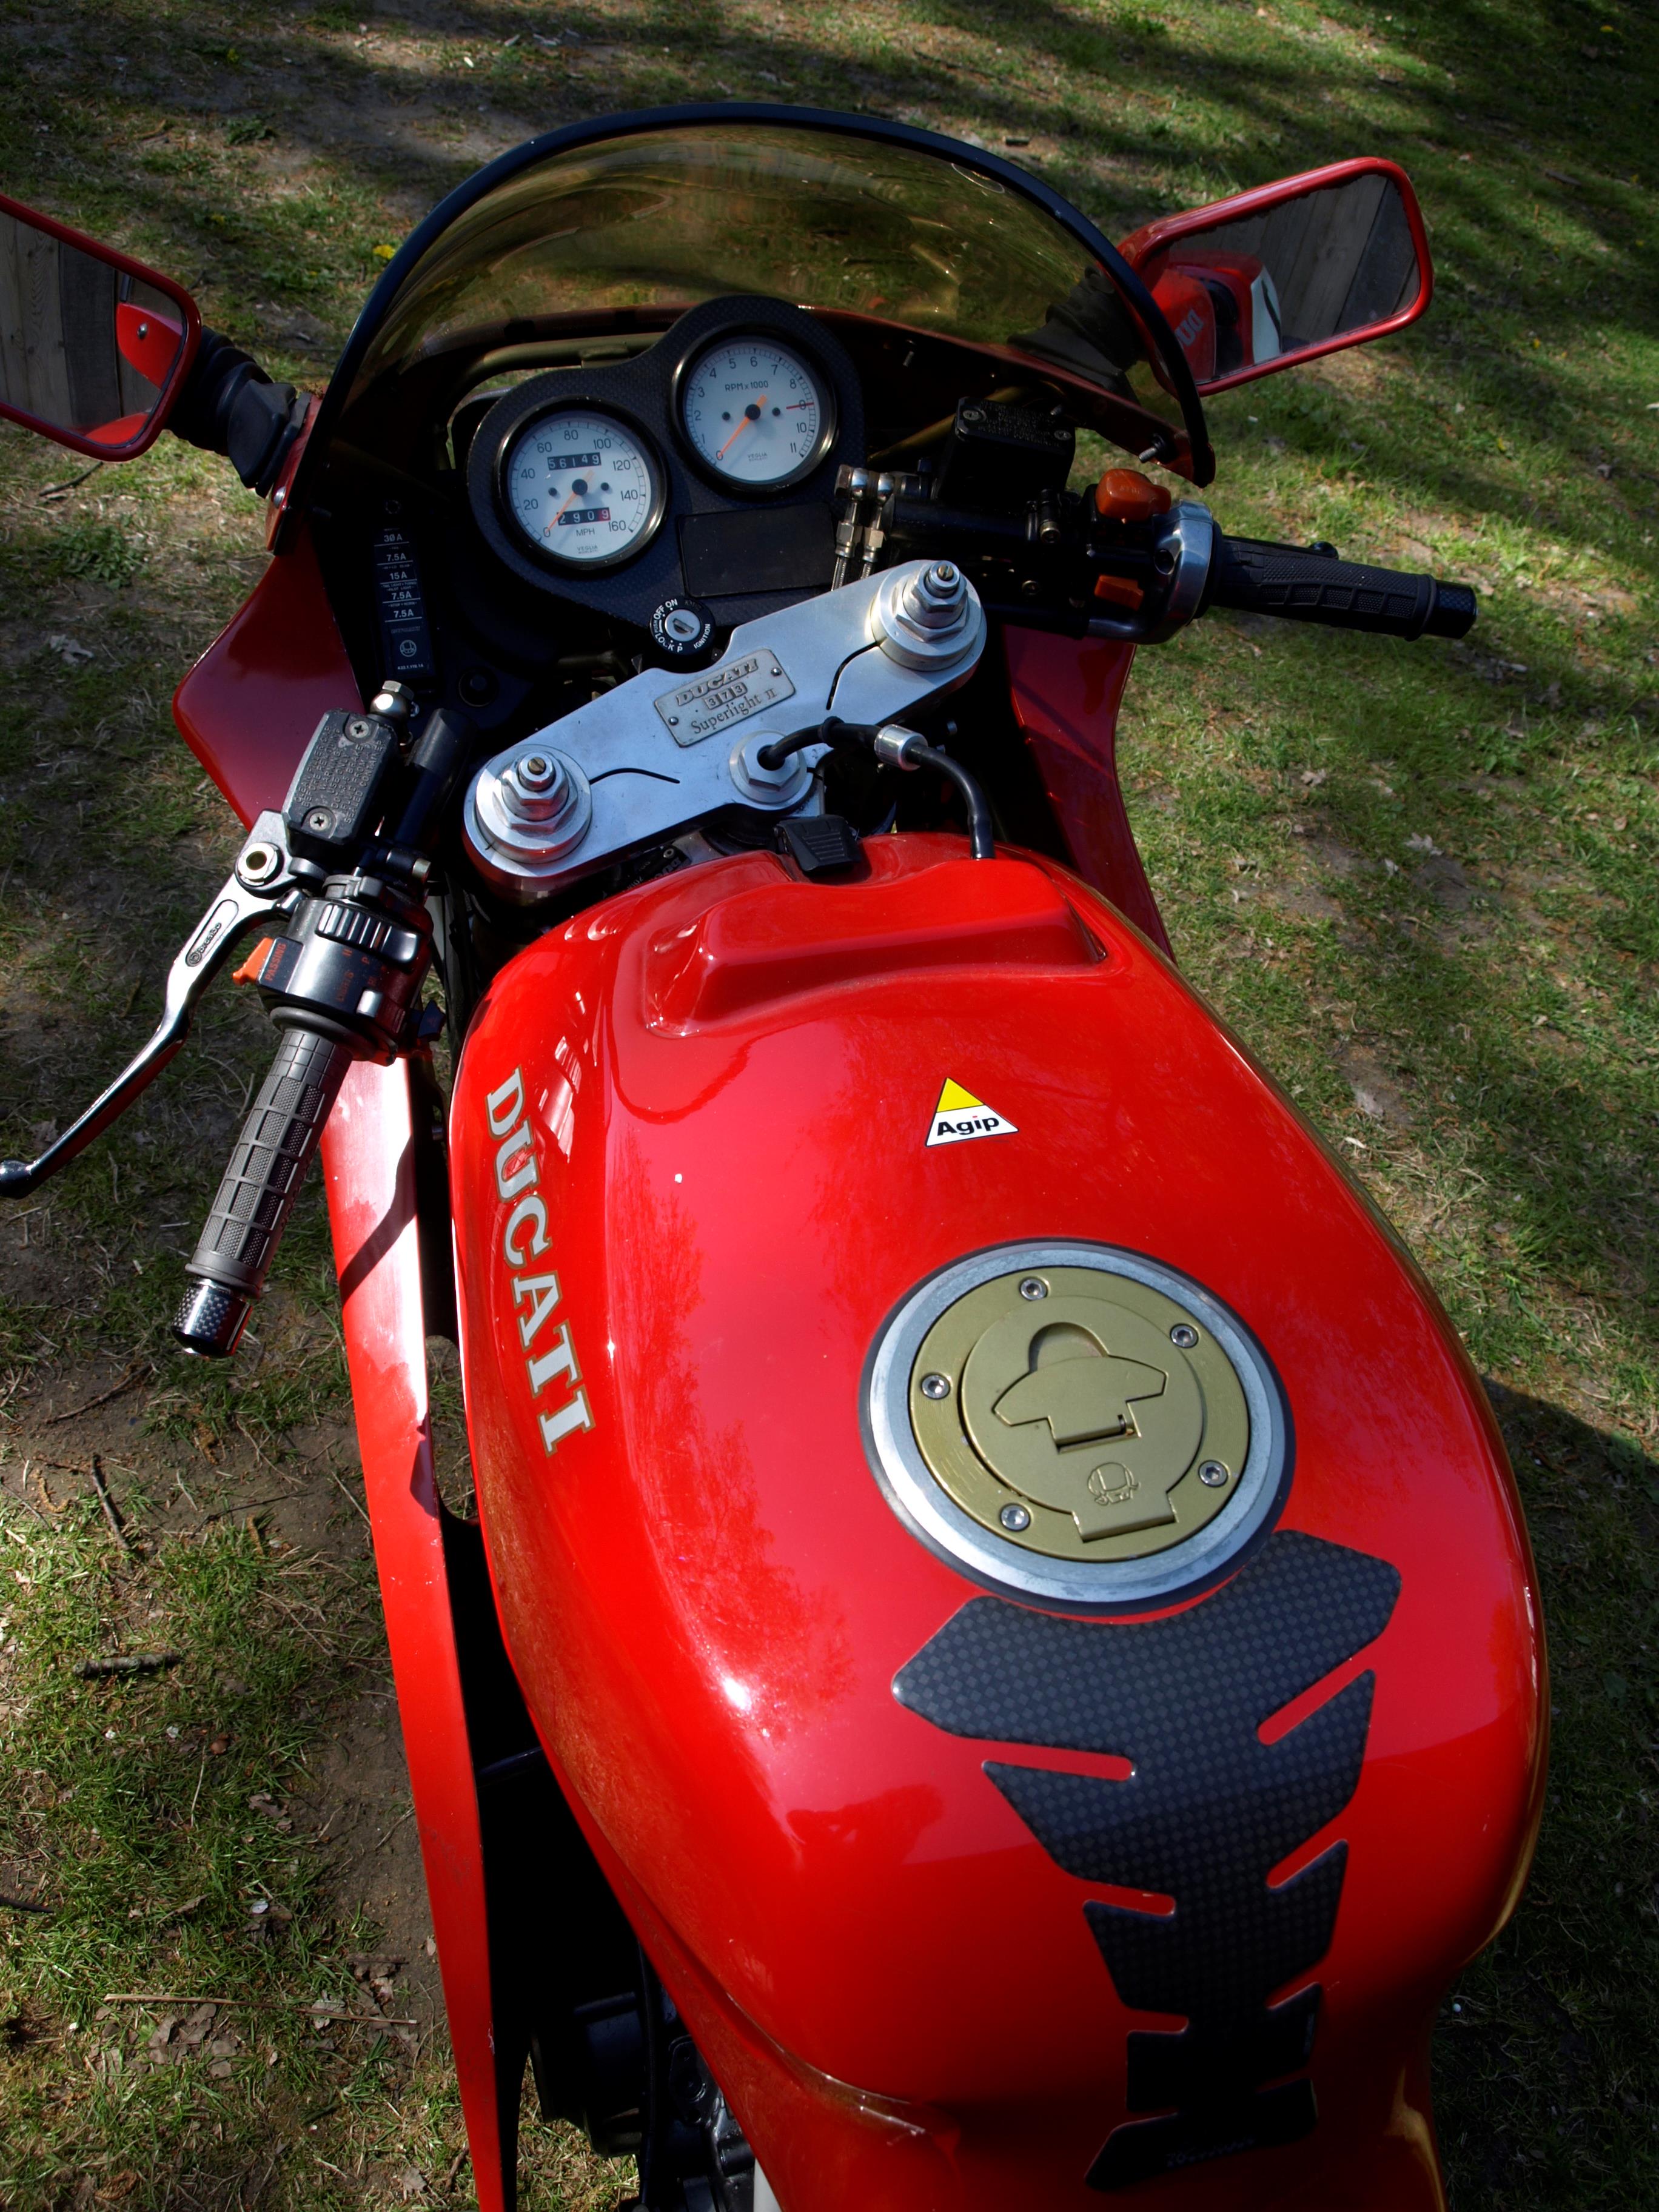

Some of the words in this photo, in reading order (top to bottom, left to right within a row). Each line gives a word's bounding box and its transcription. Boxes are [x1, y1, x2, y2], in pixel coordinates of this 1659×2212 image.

[729, 358, 737, 369] 5
[750, 357, 757, 367] 6
[709, 367, 717, 378] 4
[771, 364, 779, 375] 7
[789, 378, 796, 389] 8
[697, 387, 705, 397] 3
[799, 400, 806, 410] 9
[694, 411, 701, 421] 2
[796, 423, 806, 433] 10
[564, 429, 578, 440] 80
[537, 441, 552, 453] 60
[593, 438, 612, 449] 100
[789, 443, 796, 453] 11
[613, 460, 631, 471] 120
[520, 468, 535, 479] 40
[620, 489, 638, 501] 140
[523, 499, 538, 510] 20
[608, 520, 626, 532] 160
[543, 527, 551, 537] 0
[665, 598, 678, 608] ON
[653, 605, 665, 620] OFF
[693, 623, 711, 649] IGNITION
[675, 658, 759, 706] DUCATI
[707, 684, 745, 708] 373
[691, 691, 762, 734] Superlight
[764, 688, 777, 700] II
[329, 777, 340, 794] USE
[265, 943, 287, 982] PASSING
[937, 1115, 999, 1136] Agip
[485, 1065, 596, 1457] DUCATI
